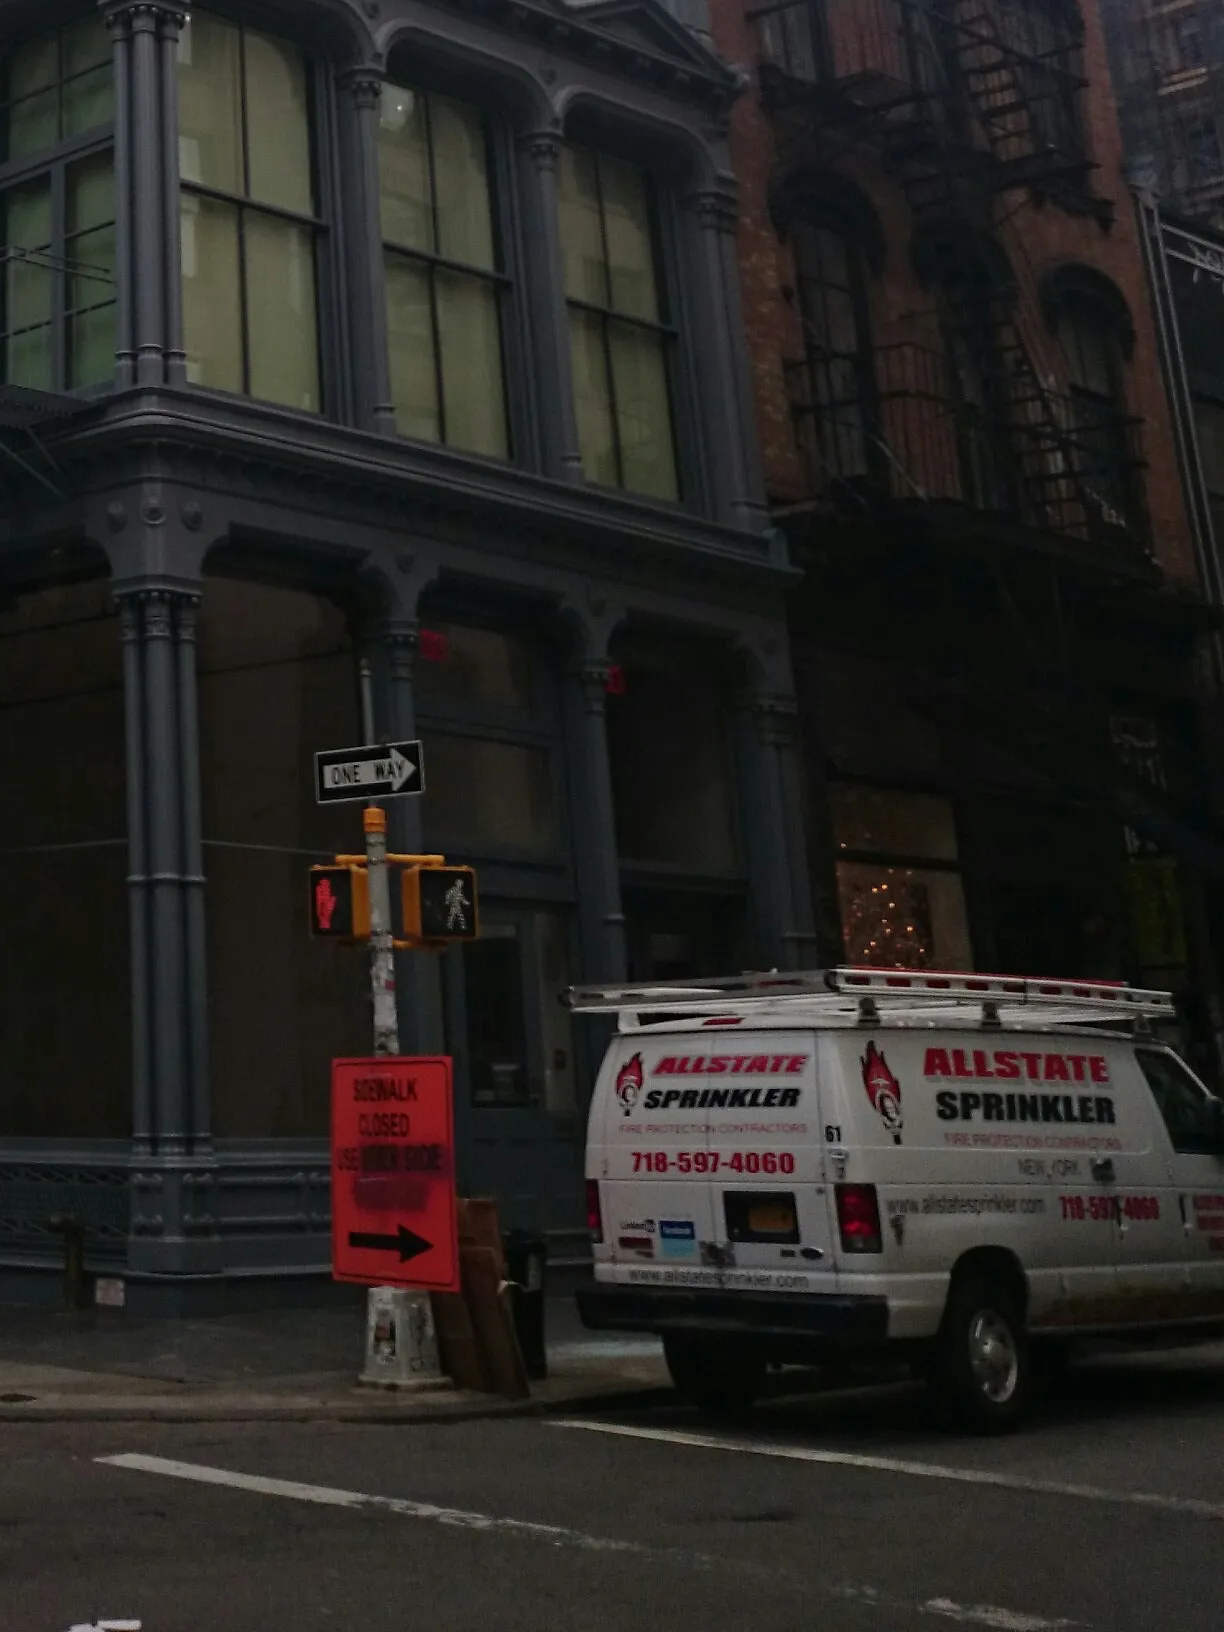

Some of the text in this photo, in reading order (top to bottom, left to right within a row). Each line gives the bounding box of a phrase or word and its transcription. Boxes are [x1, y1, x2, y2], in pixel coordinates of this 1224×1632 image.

[331, 759, 405, 784] ONE WAY
[652, 1054, 809, 1075] ALLSTATE
[923, 1047, 1110, 1084] ALLSTATE
[353, 1077, 419, 1102] SIDEWALK
[644, 1087, 801, 1109] SPRINKLER
[936, 1091, 1116, 1124] SPRINKLER
[358, 1112, 410, 1137] CLOSED
[619, 1123, 808, 1135] FIRE PROTECTION CONTRACTORS
[825, 1125, 841, 1142] 61
[944, 1132, 1123, 1151] FIRE PROTECTION CONTRACTORS
[631, 1152, 795, 1174] 718-597-4060
[1059, 1194, 1160, 1221] 718-597-4060
